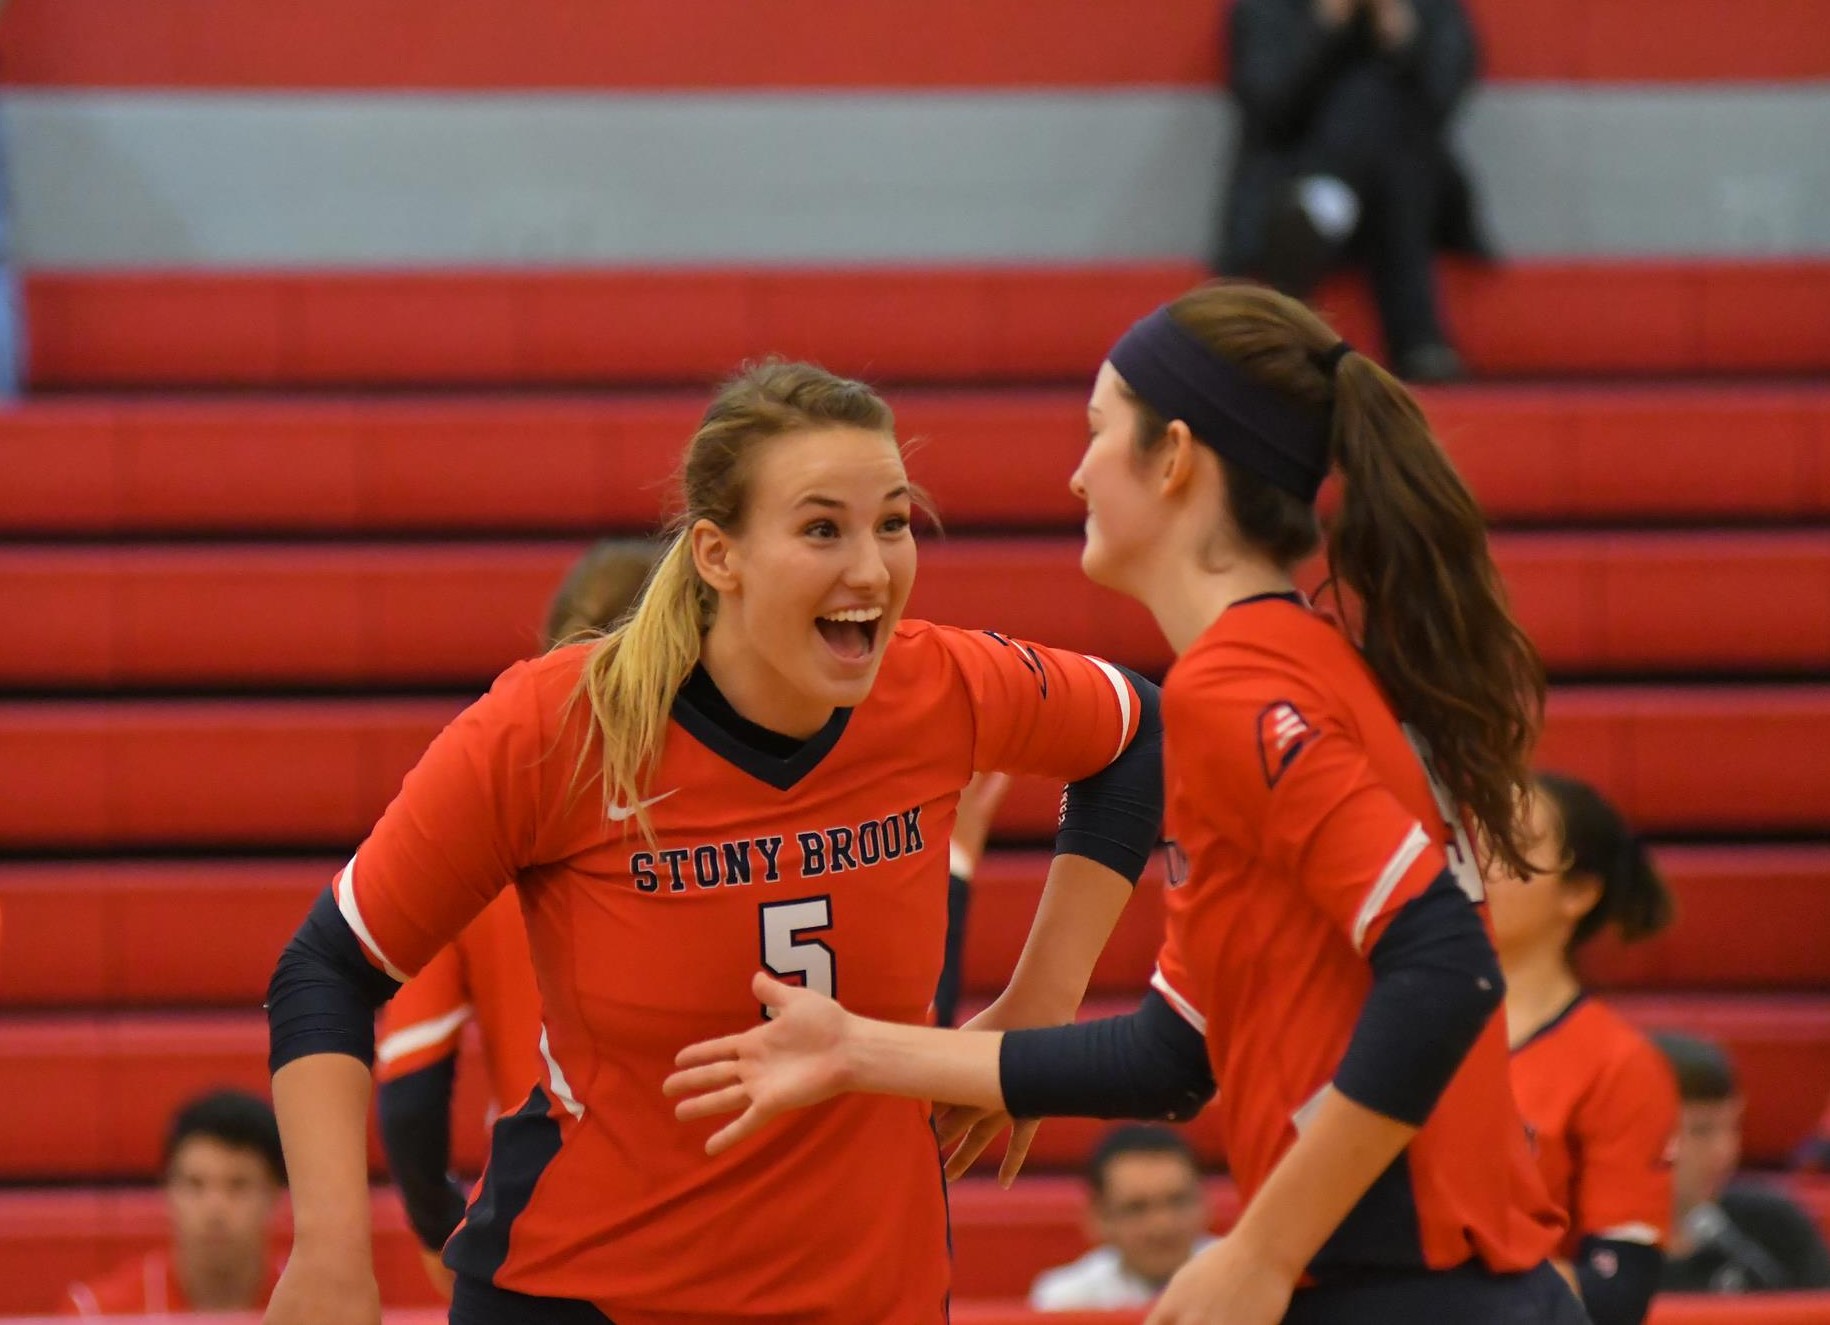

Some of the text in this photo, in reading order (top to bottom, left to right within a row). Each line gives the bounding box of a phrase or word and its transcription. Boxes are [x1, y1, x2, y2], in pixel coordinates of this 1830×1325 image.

[629, 806, 924, 893] STONY BROOK
[759, 894, 837, 1020] 5
